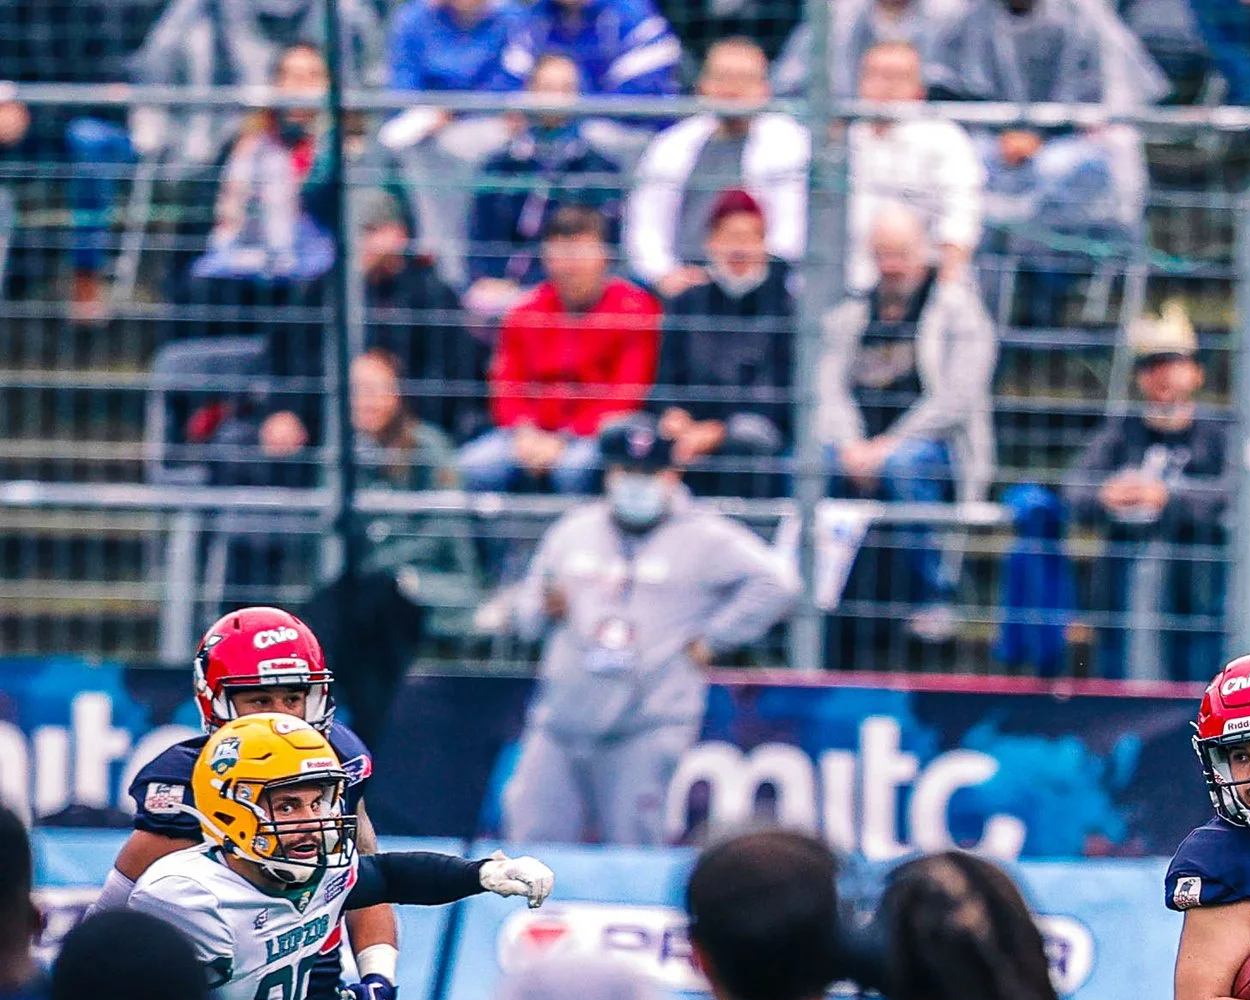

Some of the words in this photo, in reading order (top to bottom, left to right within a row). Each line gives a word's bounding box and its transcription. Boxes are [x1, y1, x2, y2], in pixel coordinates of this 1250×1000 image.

[253, 626, 298, 649] Chio
[665, 714, 1026, 862] mitc
[266, 914, 329, 964] LEIPZIG
